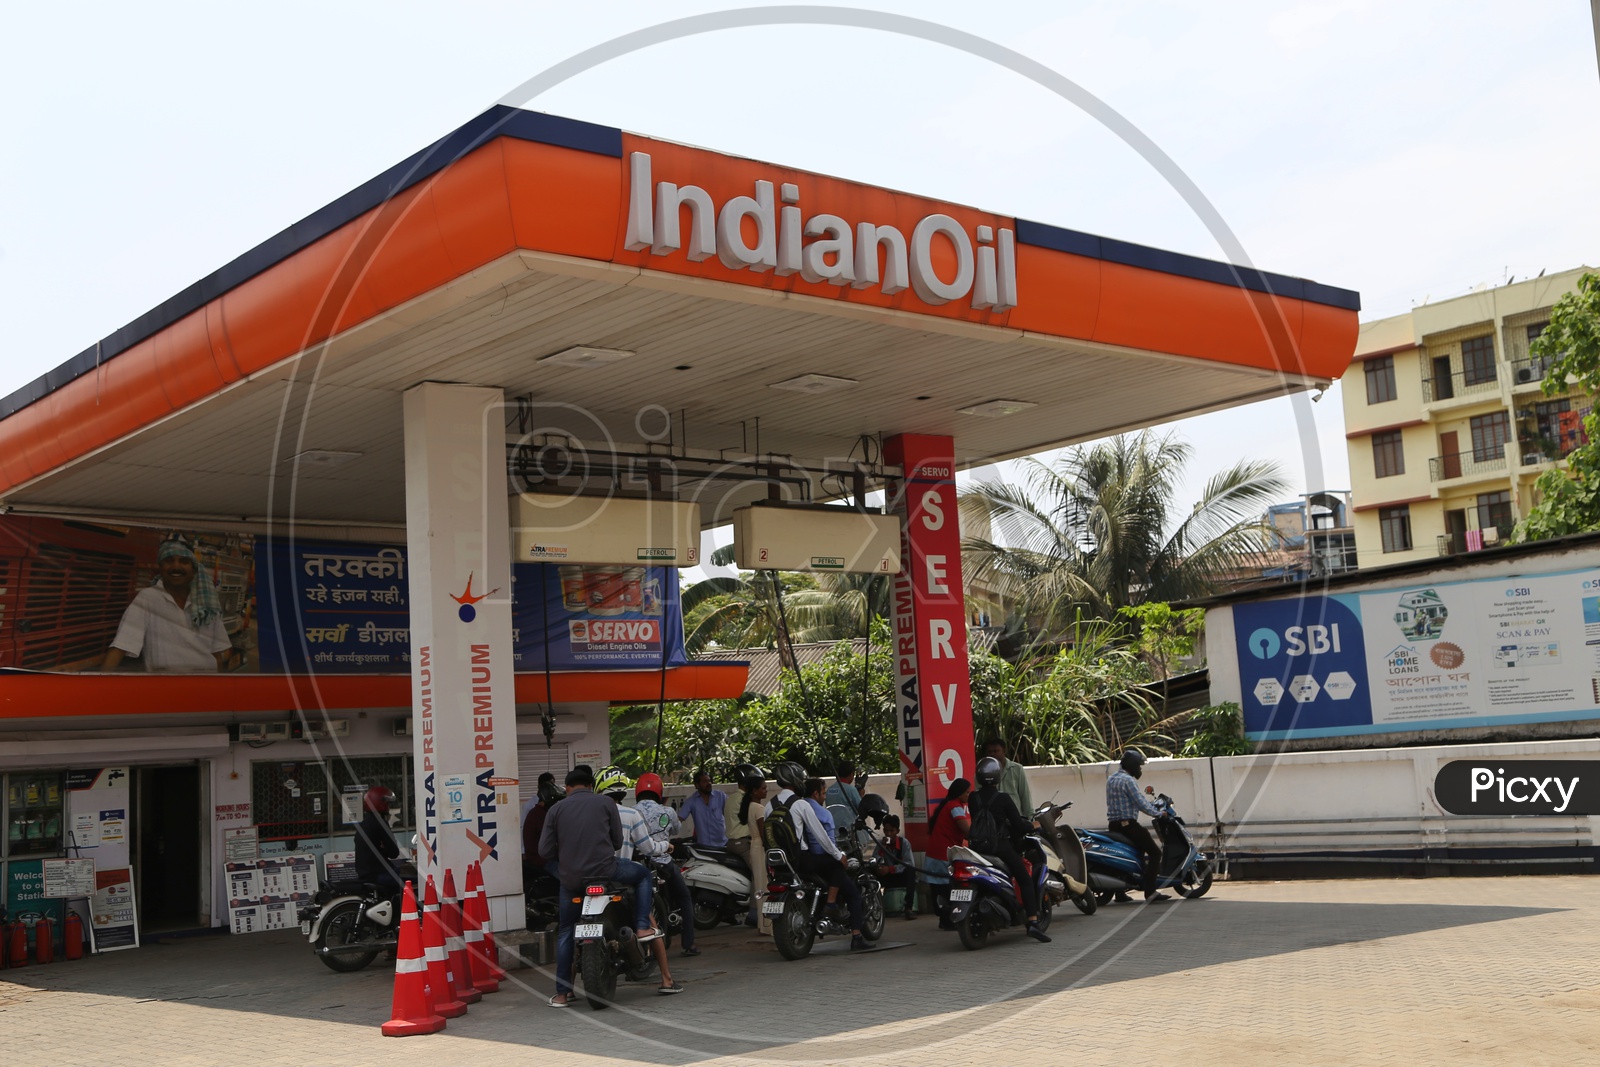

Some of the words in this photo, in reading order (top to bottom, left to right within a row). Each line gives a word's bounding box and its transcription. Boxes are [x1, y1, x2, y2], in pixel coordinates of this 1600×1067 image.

[624, 151, 1017, 314] IndianOil
[922, 467, 949, 477] SERVO
[688, 550, 694, 560] 3
[760, 550, 767, 560] 2
[302, 548, 405, 580] तरक्की
[882, 560, 888, 570] 1
[306, 584, 328, 602] रहे
[331, 584, 368, 604] इंजन
[371, 586, 405, 605] सही,
[1515, 588, 1530, 596] SBI
[592, 622, 653, 640] SERVO
[1496, 630, 1522, 639] SCAN
[1534, 628, 1552, 636] PAY
[921, 490, 964, 791] SERVO
[1285, 622, 1341, 656] SBI
[610, 643, 632, 651] Engine
[1388, 657, 1418, 667] HOME
[1390, 666, 1420, 674] LOANS
[1386, 674, 1442, 688] আপোন
[420, 646, 438, 868] XTRAPREMIUM
[466, 644, 498, 864] XTRAPREMIUM
[448, 790, 462, 803] 10
[216, 804, 234, 813] WORKING
[236, 803, 250, 812] HOURS
[14, 872, 43, 880] Welco
